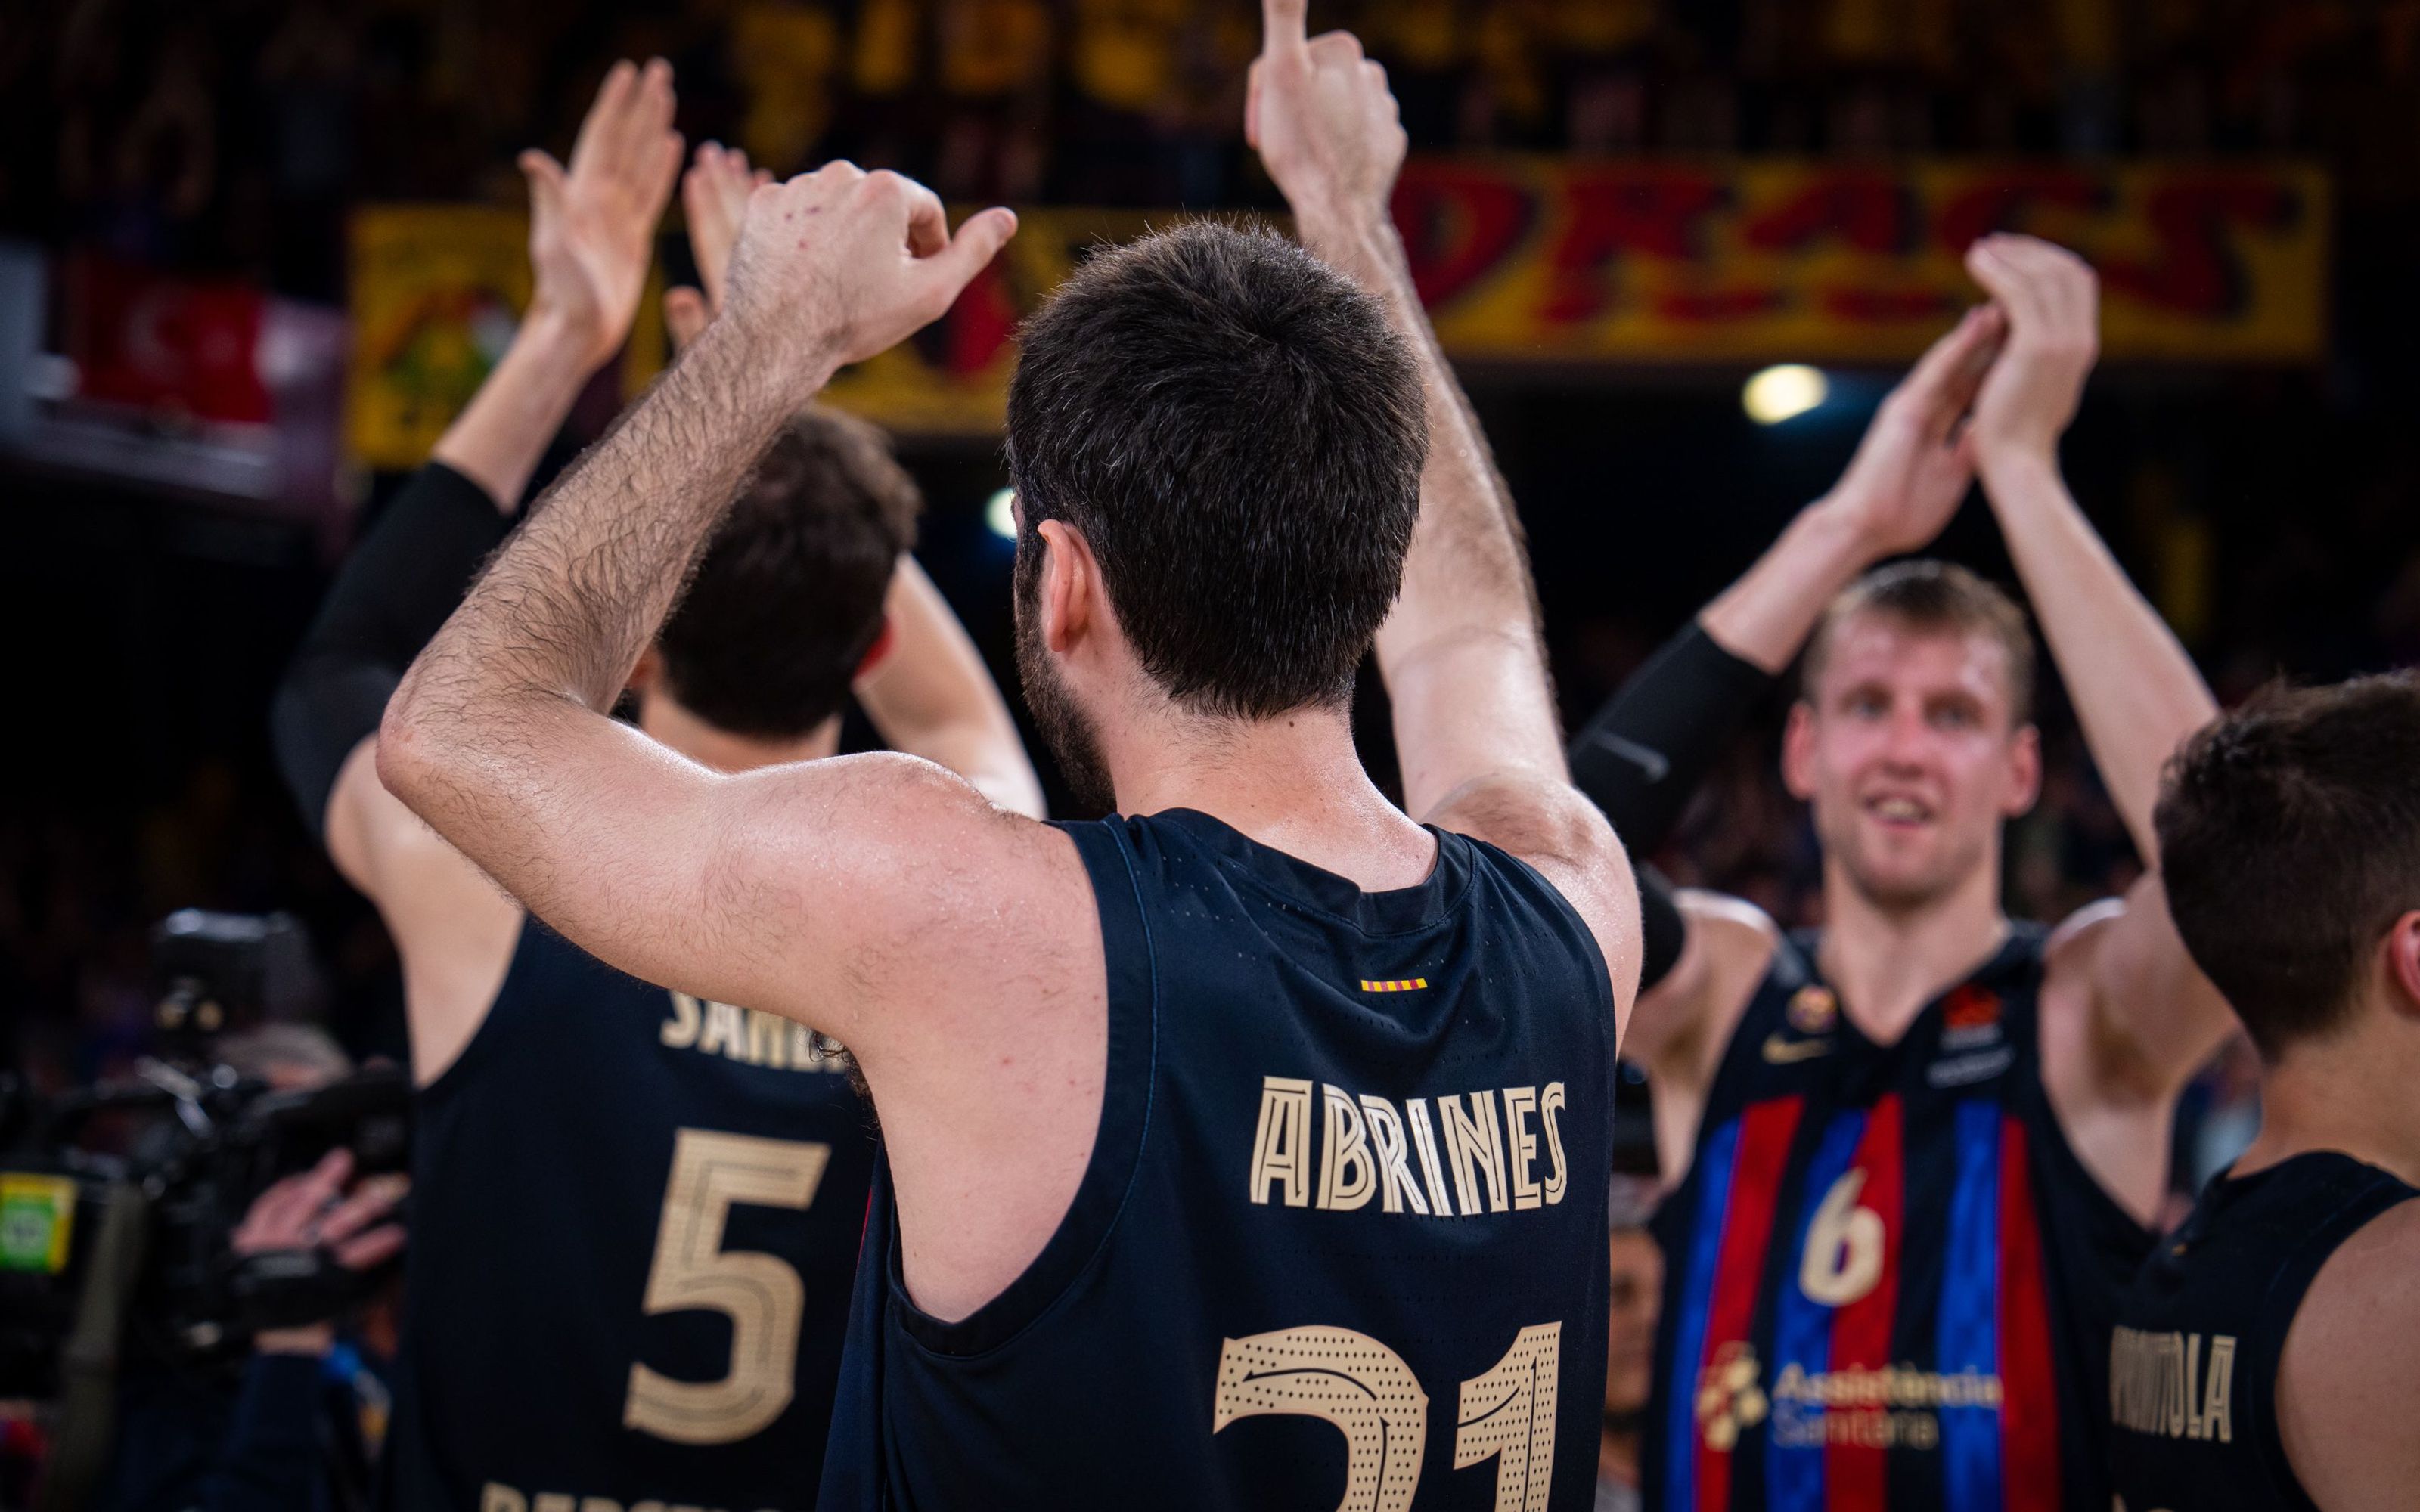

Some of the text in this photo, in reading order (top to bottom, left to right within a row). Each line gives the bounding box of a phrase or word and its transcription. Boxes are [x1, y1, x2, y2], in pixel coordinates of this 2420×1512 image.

[1250, 1076, 1566, 1216] ABRINES
[622, 1126, 830, 1445] 5
[1798, 1167, 1885, 1306] 6
[1212, 1321, 1562, 1512] 21
